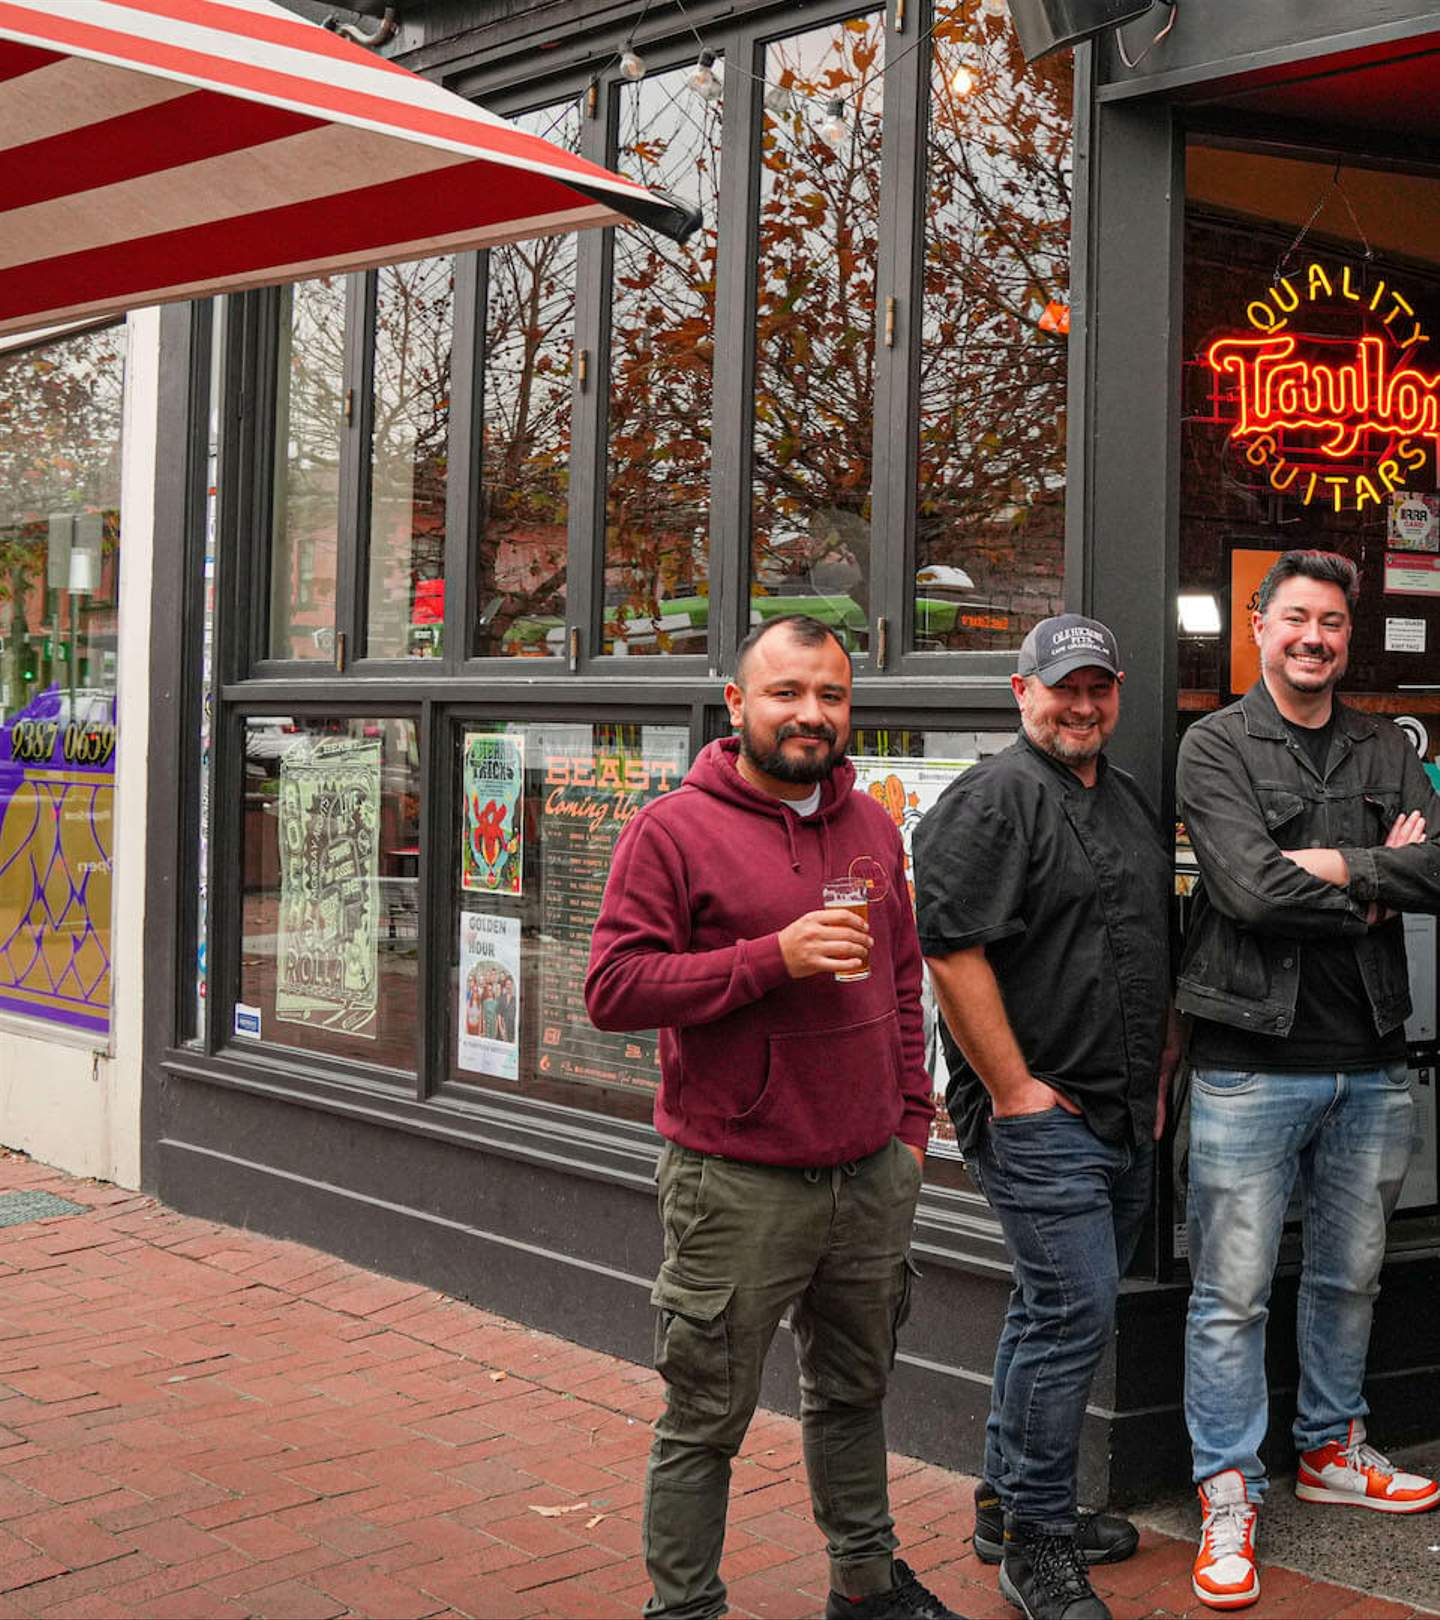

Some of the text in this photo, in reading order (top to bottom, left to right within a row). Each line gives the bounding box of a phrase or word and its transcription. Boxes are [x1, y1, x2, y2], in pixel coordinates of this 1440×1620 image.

[1247, 264, 1430, 349] QUALITY
[1247, 435, 1427, 512] GUITARS
[11, 721, 58, 762] 9387
[544, 756, 679, 792] BEAST
[545, 785, 609, 833] Coming
[469, 916, 507, 935] GOLDEN
[468, 941, 496, 957] HOUR
